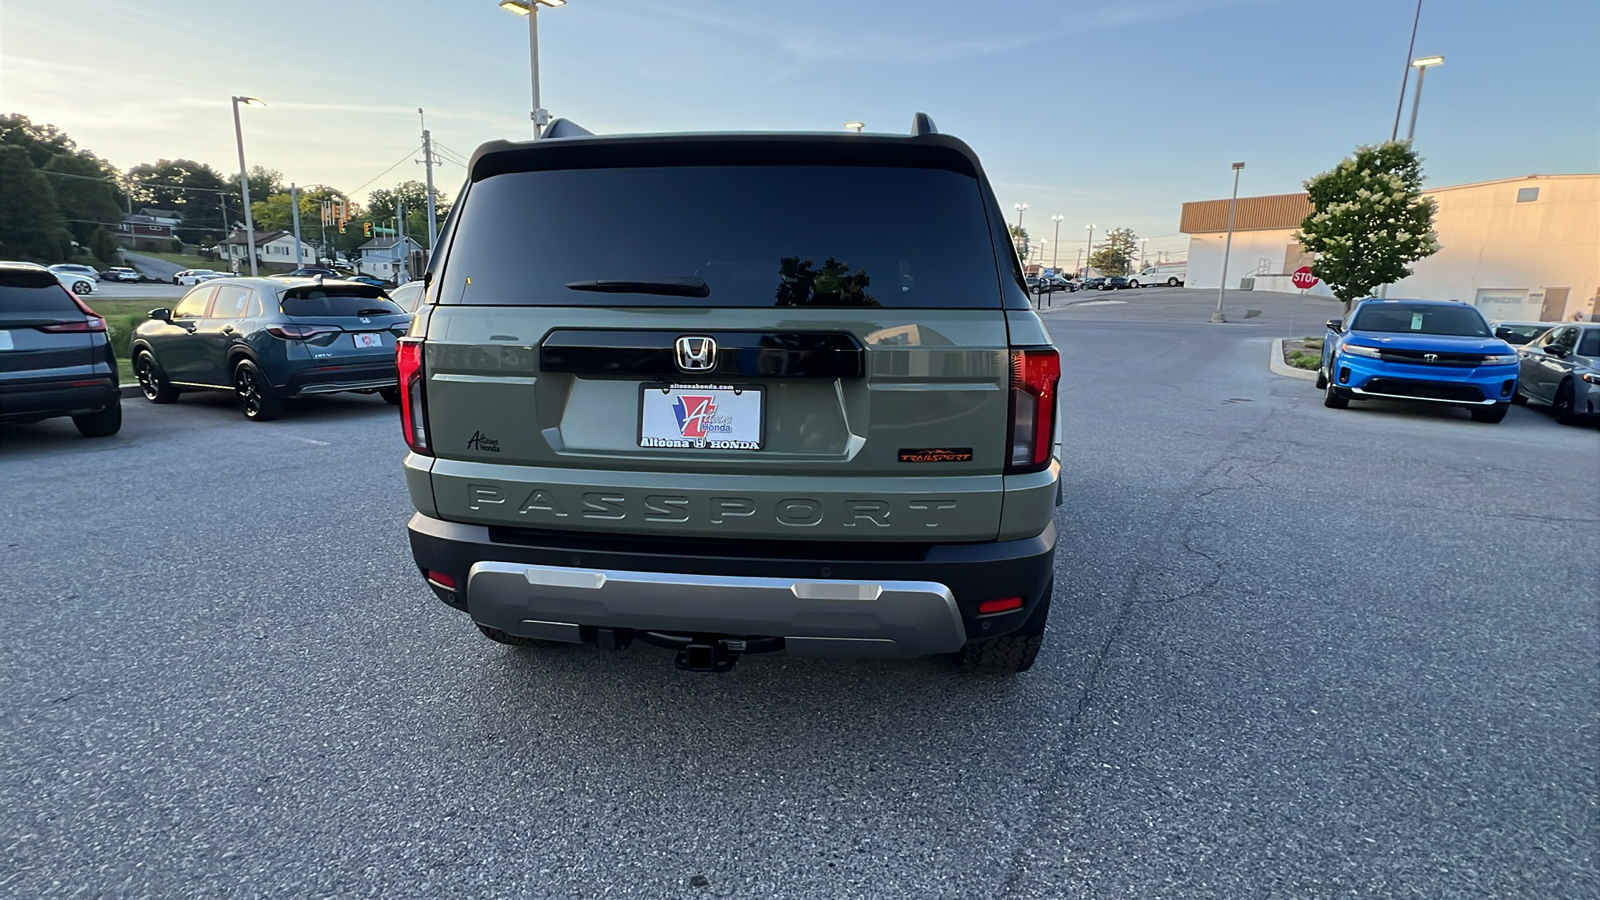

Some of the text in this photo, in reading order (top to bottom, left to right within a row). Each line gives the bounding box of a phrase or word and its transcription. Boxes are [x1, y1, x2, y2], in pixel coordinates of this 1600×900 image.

[1293, 272, 1319, 283] STOP
[702, 423, 731, 432] Honda
[640, 437, 690, 448] Altoona
[710, 440, 760, 450] HONDA
[467, 483, 957, 528] PASSPORT
